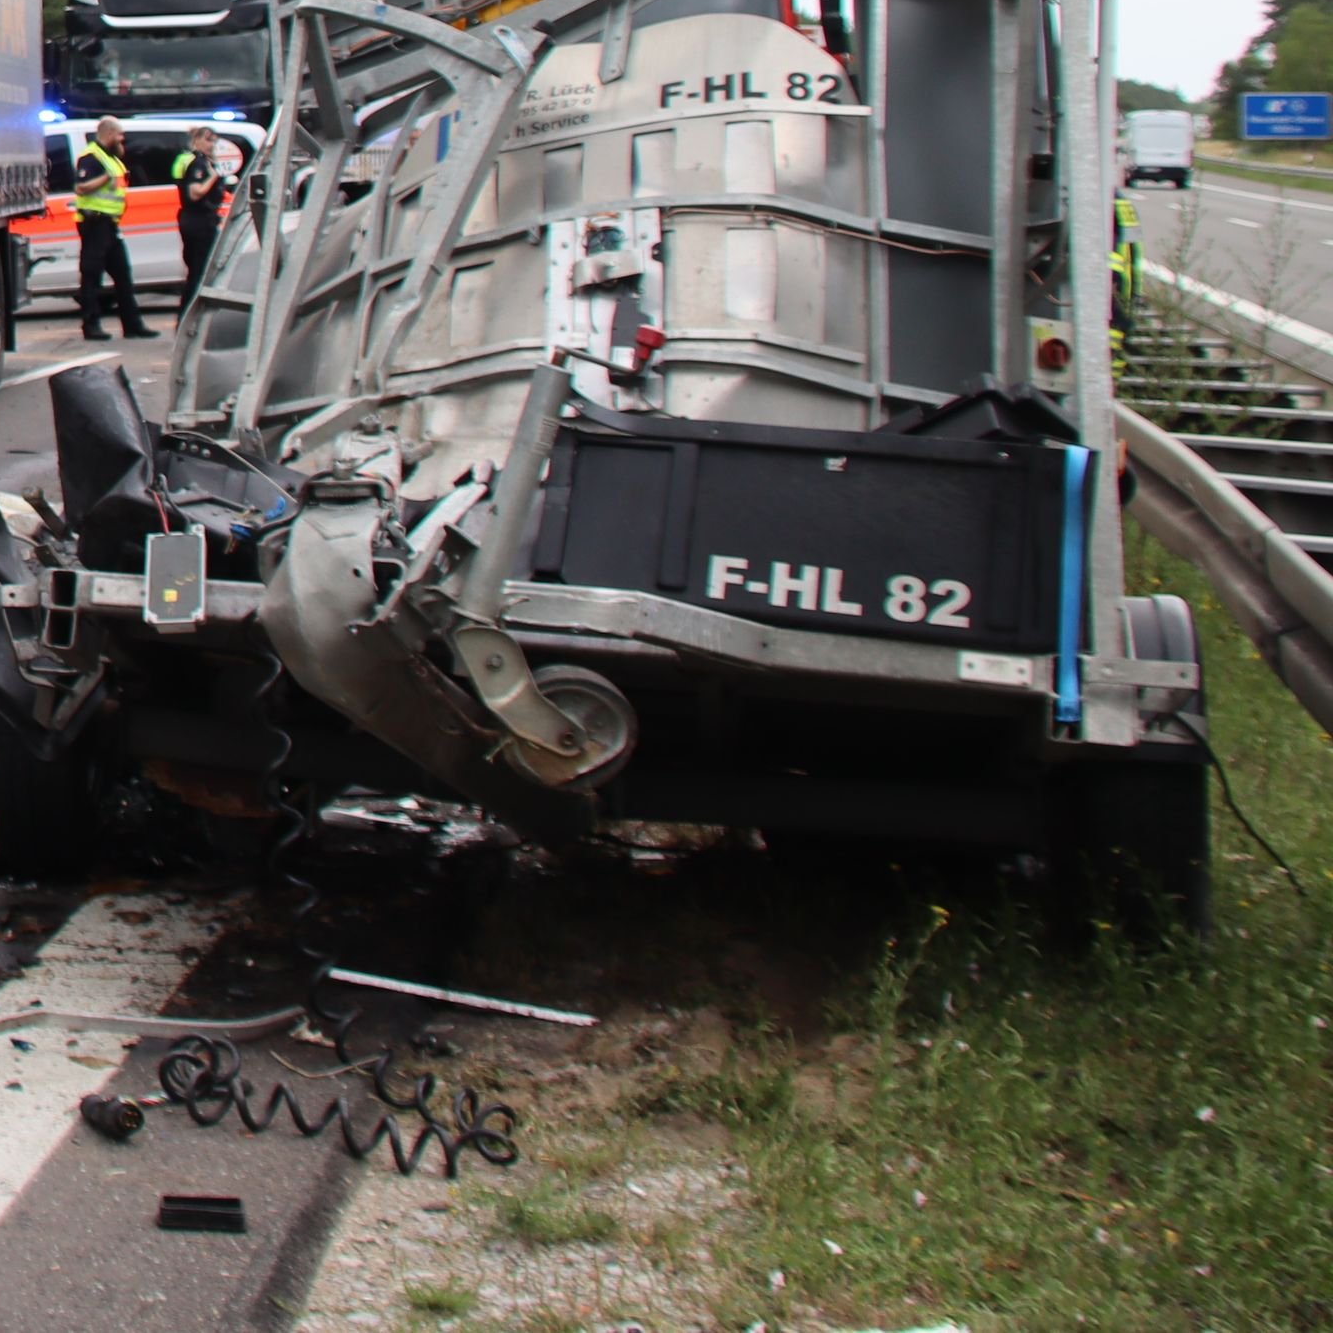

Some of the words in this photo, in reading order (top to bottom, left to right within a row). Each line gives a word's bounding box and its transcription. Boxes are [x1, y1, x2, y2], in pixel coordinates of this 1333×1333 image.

[550, 83, 595, 98] Lück
[660, 71, 767, 109] F-HL
[786, 71, 842, 105] 82
[530, 113, 590, 135] Service
[706, 554, 862, 616] F-HL
[883, 574, 972, 628] 82
